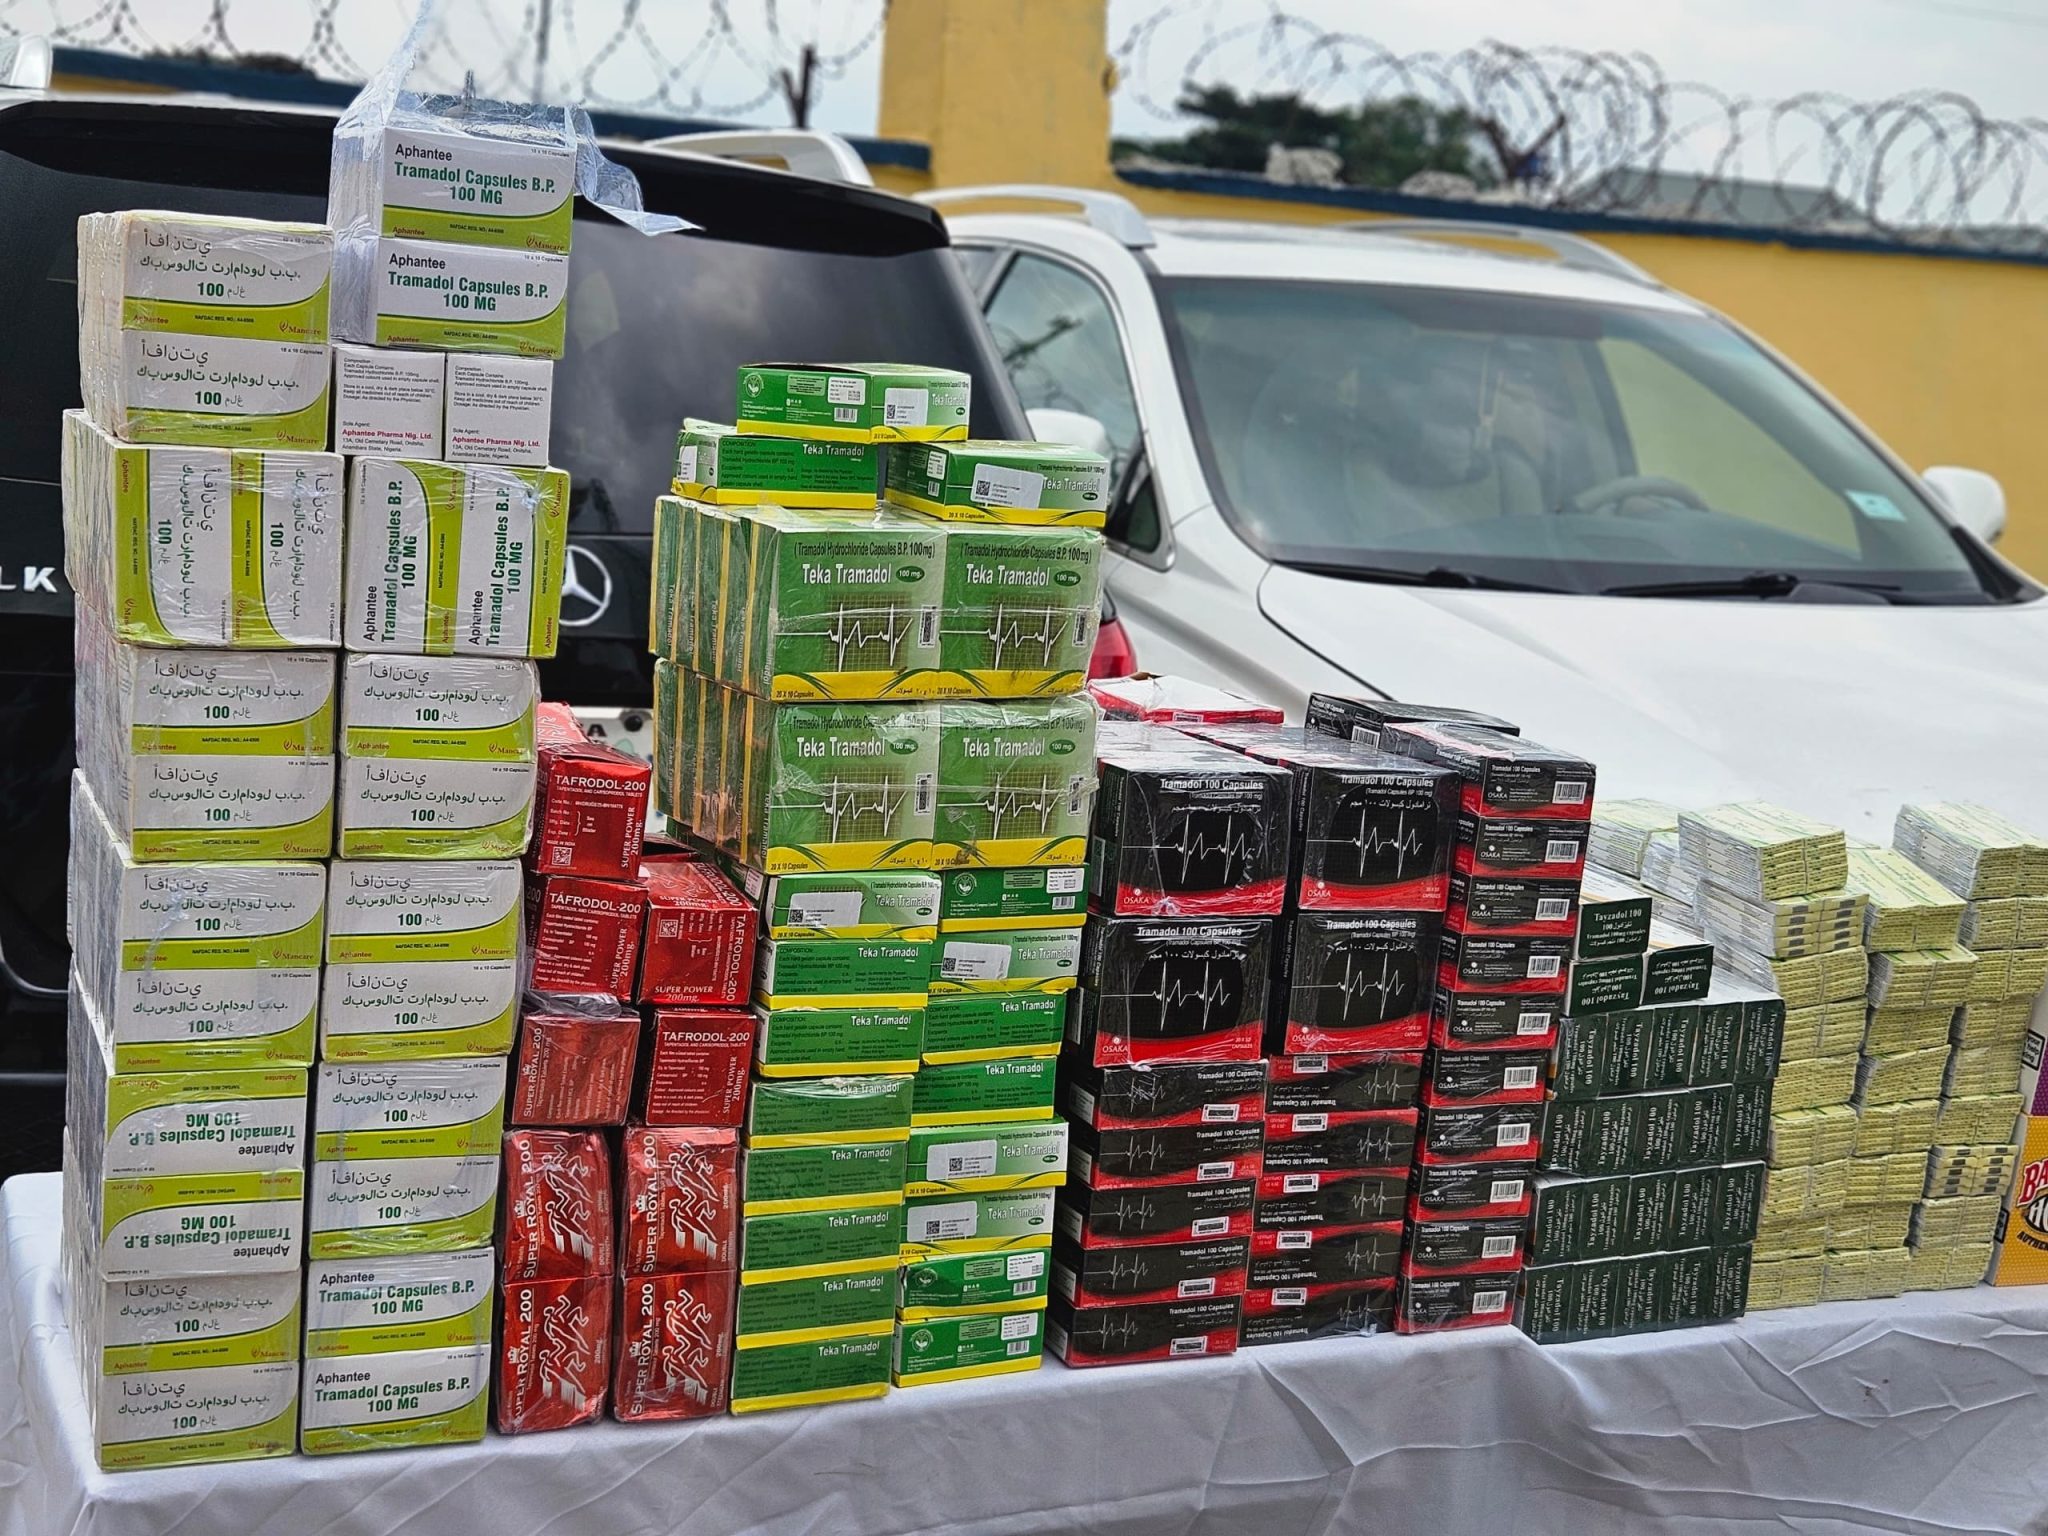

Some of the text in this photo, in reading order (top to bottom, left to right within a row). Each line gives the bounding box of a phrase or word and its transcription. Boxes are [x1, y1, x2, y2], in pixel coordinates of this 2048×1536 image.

[395, 144, 452, 161] Aphantee
[395, 162, 555, 193] Tramadol Capsules B.P.
[450, 186, 502, 204] 100 MG
[389, 253, 446, 269] Aphantee
[198, 282, 224, 296] 100
[388, 271, 548, 298] Tramadol Capsules B.P.
[443, 294, 496, 311] 100 MG
[195, 391, 221, 405] 100
[342, 429, 375, 438] Aphantee
[379, 430, 403, 439] Pharma
[406, 431, 418, 439] Nig.
[453, 436, 484, 444] Aphantee
[486, 438, 511, 446] Pharma
[513, 439, 525, 447] Nig.
[803, 444, 864, 456] Teka Tramadol
[158, 519, 172, 544] 100
[491, 516, 509, 578] Capsules
[870, 542, 896, 558] Capsules
[382, 480, 402, 642] Tramadol Capsules B.P.
[403, 535, 417, 589] 100 MG
[508, 542, 523, 594] 100 MG
[802, 564, 831, 584] Teka
[836, 564, 891, 584] Tramadol
[967, 564, 993, 584] Teka
[998, 565, 1049, 586] Tramadol
[363, 585, 377, 642] Aphantee
[469, 590, 483, 645] Aphantee
[486, 582, 504, 646] Tramadol
[204, 706, 230, 718] 100
[416, 709, 439, 721] 100
[797, 737, 825, 757] Teka
[830, 736, 885, 757] Tramadol
[963, 737, 989, 757] Teka
[994, 738, 1044, 756] Tramadol
[555, 775, 646, 791] TAFRODOL-200
[1159, 778, 1264, 791] Tramadol 100 Capsules
[1342, 775, 1434, 789] Tramadol 100 Capsules
[205, 808, 230, 821] 100
[411, 809, 435, 821] 100
[621, 807, 635, 868] SUPER POWER
[1123, 896, 1149, 905] OSAKA
[1307, 889, 1331, 899] OSAKA
[550, 893, 641, 913] TAFRODOL-200
[398, 914, 422, 926] 100
[1629, 909, 1642, 917] 100
[195, 918, 220, 931] 100
[1137, 927, 1242, 936] Tramadol 100 Capsules
[610, 928, 627, 989] SUPER POWER
[727, 914, 746, 1001] TAFRODOL-200
[858, 946, 919, 958] Teka Tramadol
[1001, 1000, 1056, 1013] Teka Tramadol
[851, 1014, 911, 1026] Teka Tramadol
[663, 1032, 750, 1041] TAFRODOL-200
[1102, 1044, 1128, 1053] OSAKA
[524, 1028, 542, 1117] SUPER ROYAL 200
[186, 1114, 209, 1127] MG
[384, 1110, 408, 1122] 100
[129, 1126, 296, 1146] Tramadol Capsules B.P.
[1196, 1128, 1260, 1139] Tramadol 100 Capsules
[239, 1144, 294, 1155] Aphantee
[831, 1147, 892, 1161] Teka Tramadol
[520, 1140, 538, 1278] SUPER ROYAL 200
[643, 1135, 658, 1272] SUPER ROYAL 200
[181, 1215, 236, 1230] 100 MG
[124, 1228, 291, 1248] Tramadol Capsules B.P.
[233, 1246, 290, 1257] Aphantee
[320, 1273, 375, 1286] Aphantee
[320, 1280, 475, 1303] Tramadol Capsules B.P.
[372, 1299, 423, 1315] 100 MG
[1169, 1306, 1196, 1315] Tramadol
[1209, 1303, 1234, 1312] Capsules
[631, 1283, 653, 1414] SUPER ROYAL 200
[818, 1341, 880, 1357] Teka Tramadol
[316, 1372, 370, 1385] Aphantee
[315, 1377, 470, 1402] Tramadol Capsules B.P.
[368, 1397, 418, 1412] 100 MG
